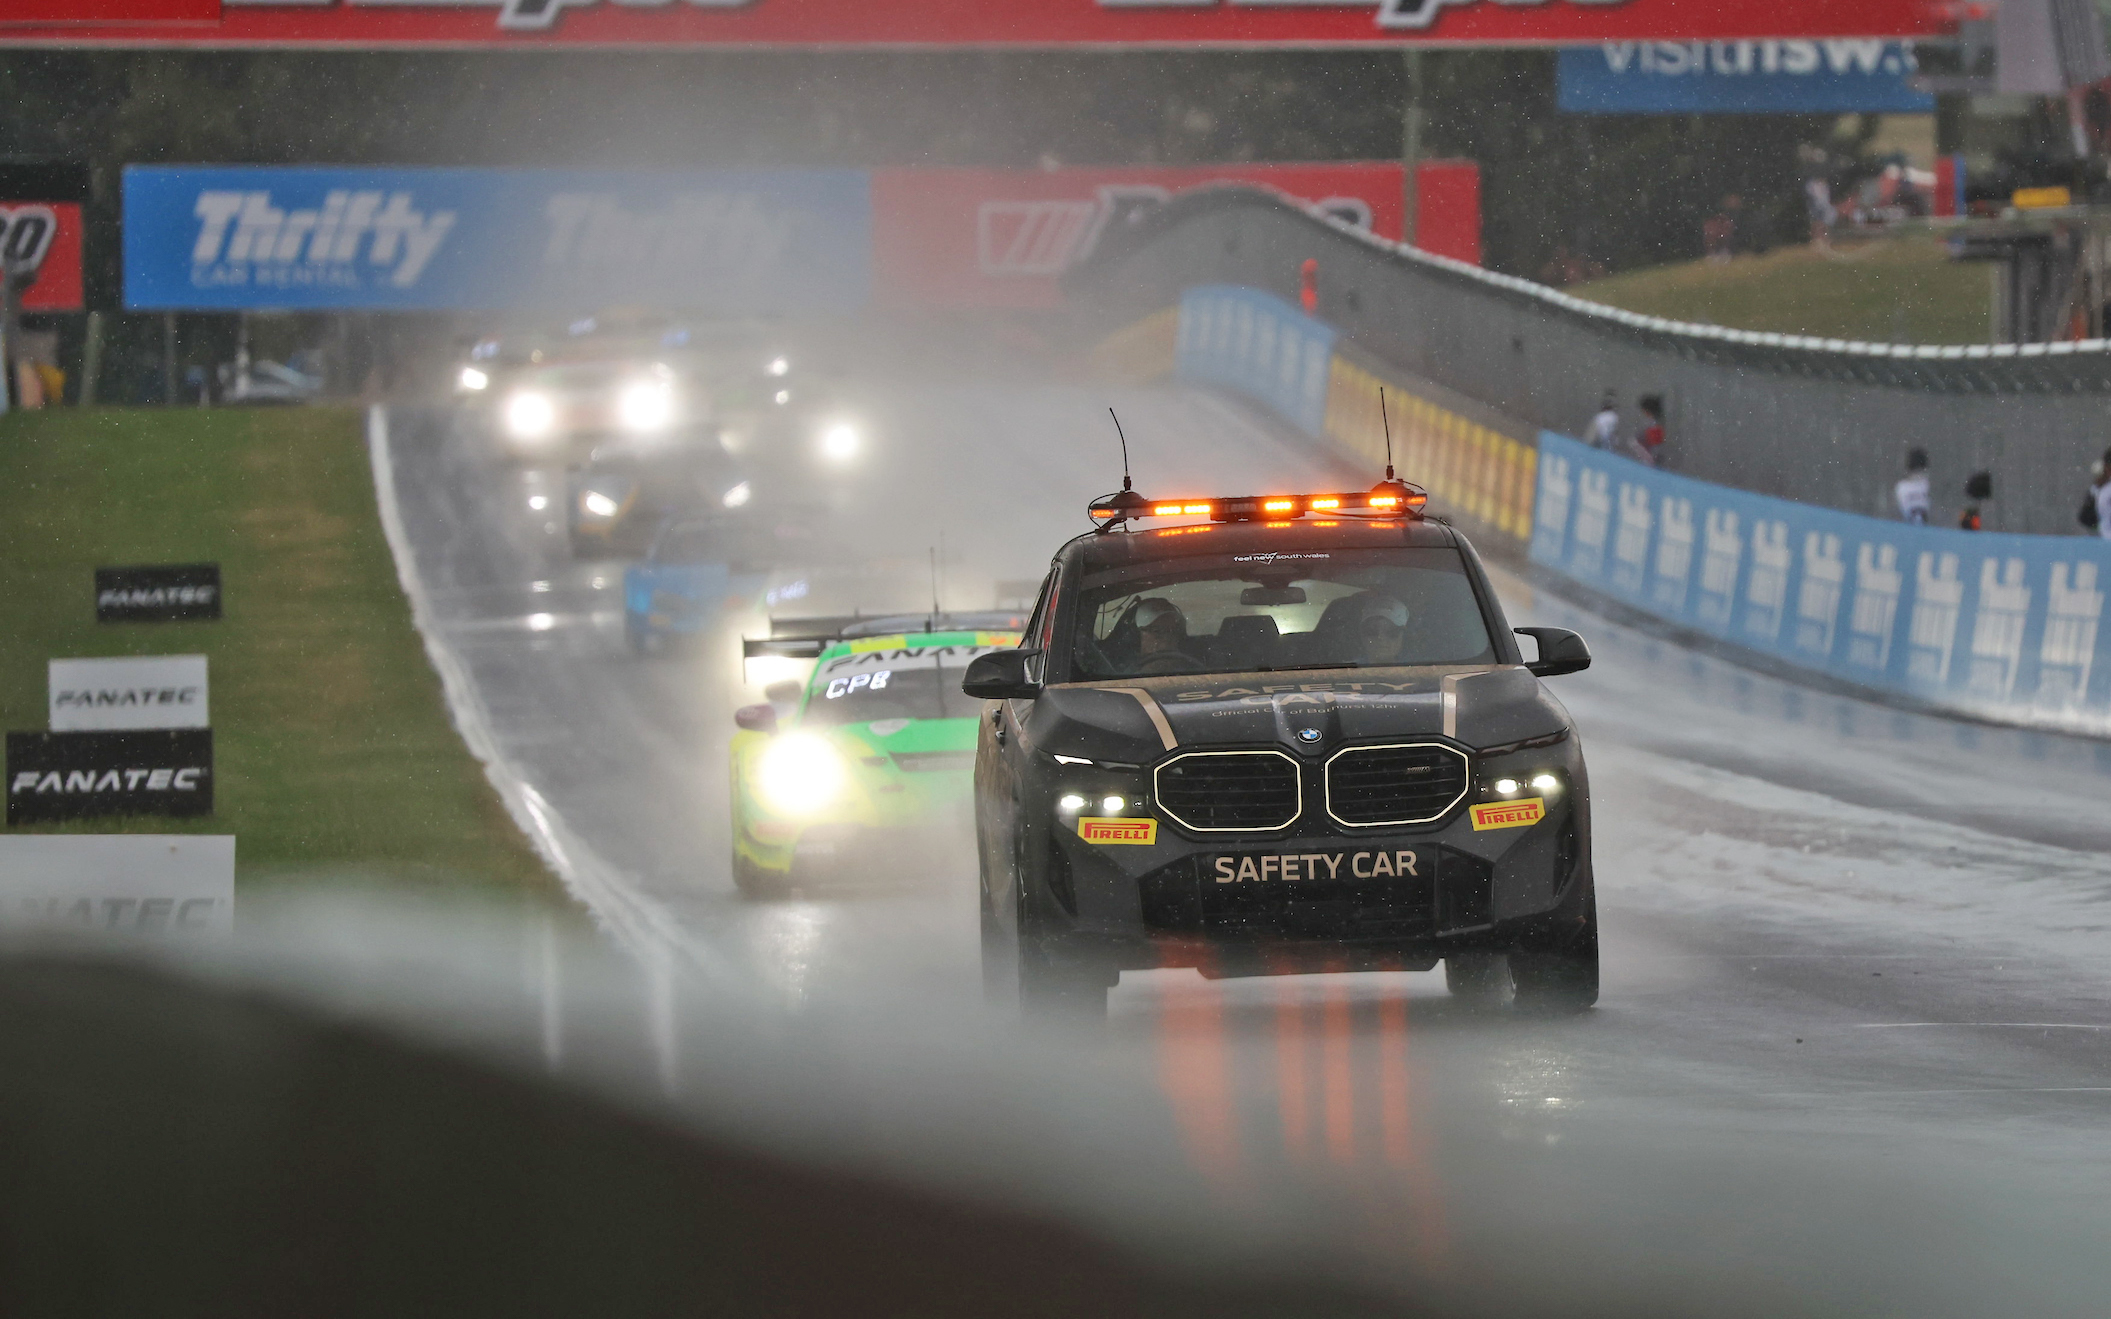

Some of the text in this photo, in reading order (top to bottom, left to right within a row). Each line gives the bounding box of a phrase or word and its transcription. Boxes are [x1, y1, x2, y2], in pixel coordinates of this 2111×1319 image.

[194, 190, 457, 288] Thrifty
[99, 585, 214, 608] FANATEC
[826, 645, 1003, 673] FANAT
[56, 686, 198, 709] FANATEC
[1176, 682, 1416, 702] SAFETY
[1239, 691, 1365, 706] CAR
[12, 768, 201, 793] FANATEC
[1476, 803, 1539, 825] PIRELLI
[1084, 822, 1150, 839] PIRELLI
[1215, 850, 1418, 884] SAFETY CAR
